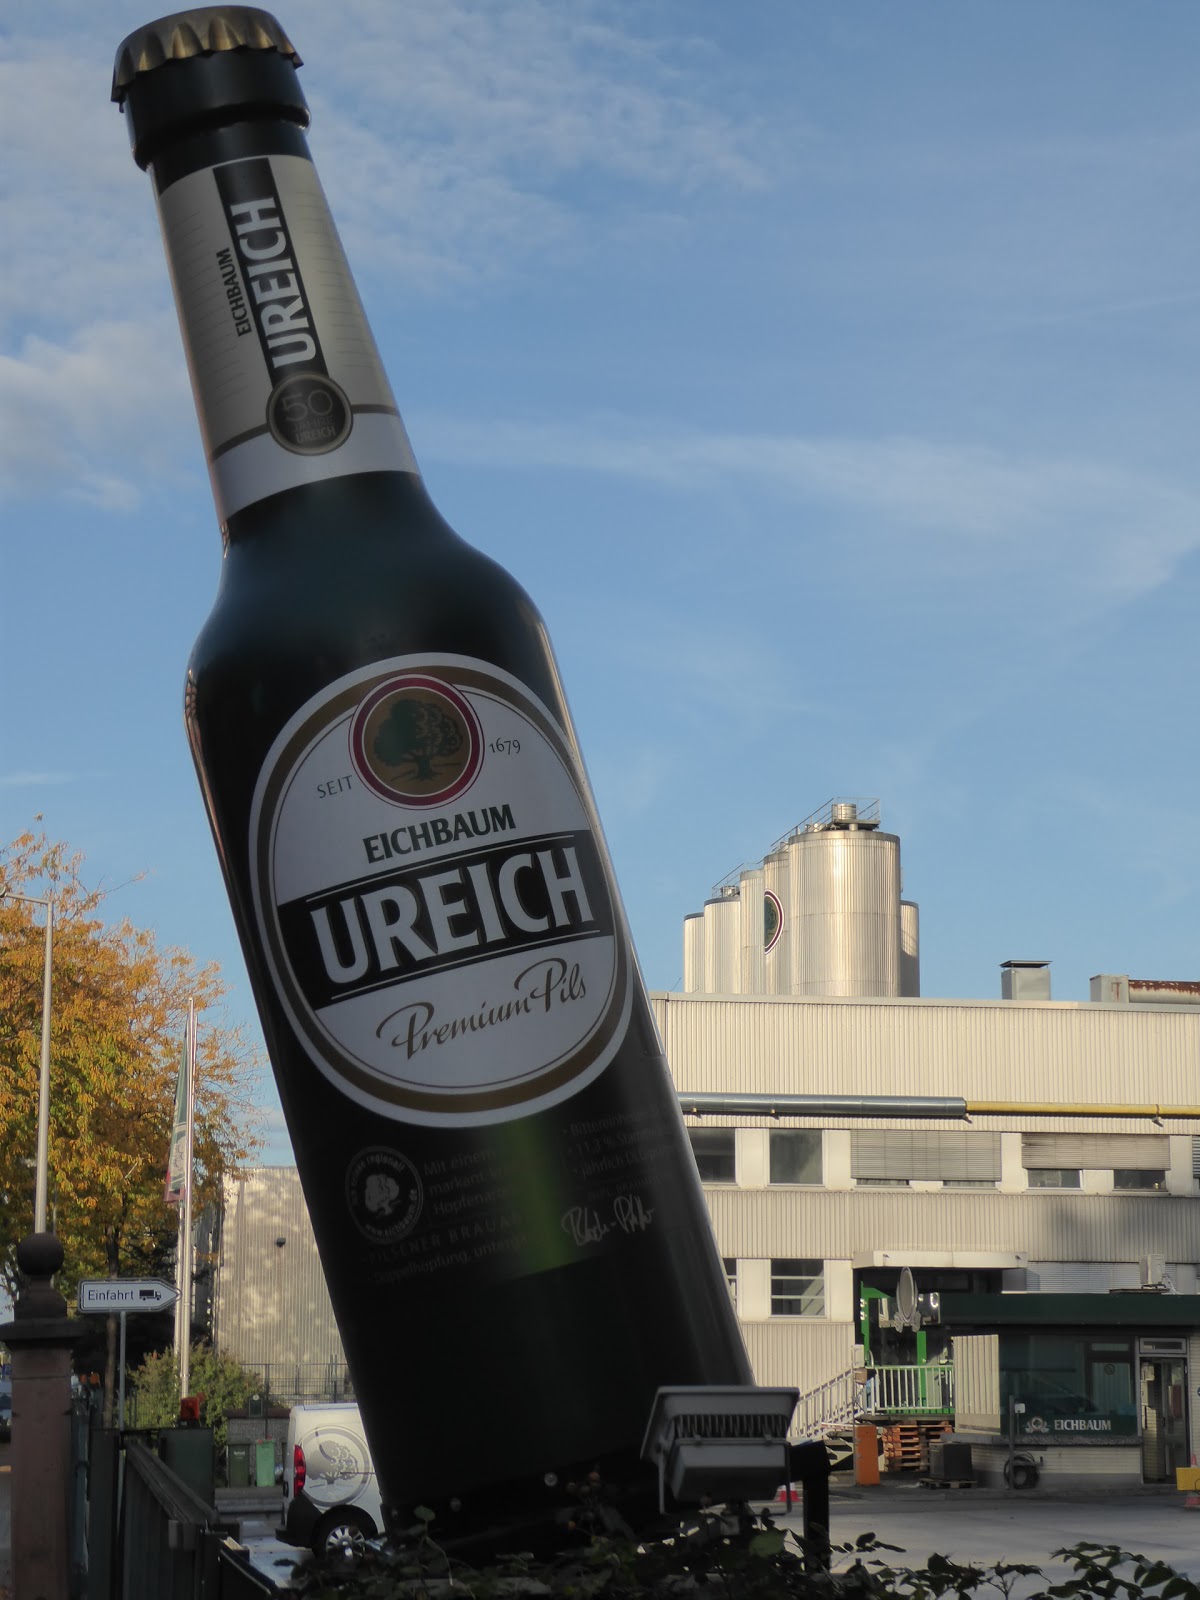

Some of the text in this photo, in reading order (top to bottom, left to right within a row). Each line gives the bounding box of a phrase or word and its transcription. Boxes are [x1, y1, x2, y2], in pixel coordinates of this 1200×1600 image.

[216, 247, 252, 336] EICHBAUM
[230, 196, 317, 369] UREICH
[281, 389, 333, 421] 50
[295, 426, 336, 443] UREICH
[488, 737, 521, 755] 1679
[316, 775, 353, 798] SEIT
[362, 804, 516, 864] EICHBAUM
[309, 847, 595, 985] UREICH
[376, 957, 587, 1060] Premium Pils
[423, 1160, 446, 1177] Mit
[88, 1289, 134, 1301] Einfahrt
[1054, 1419, 1112, 1431] EICHBAUM
